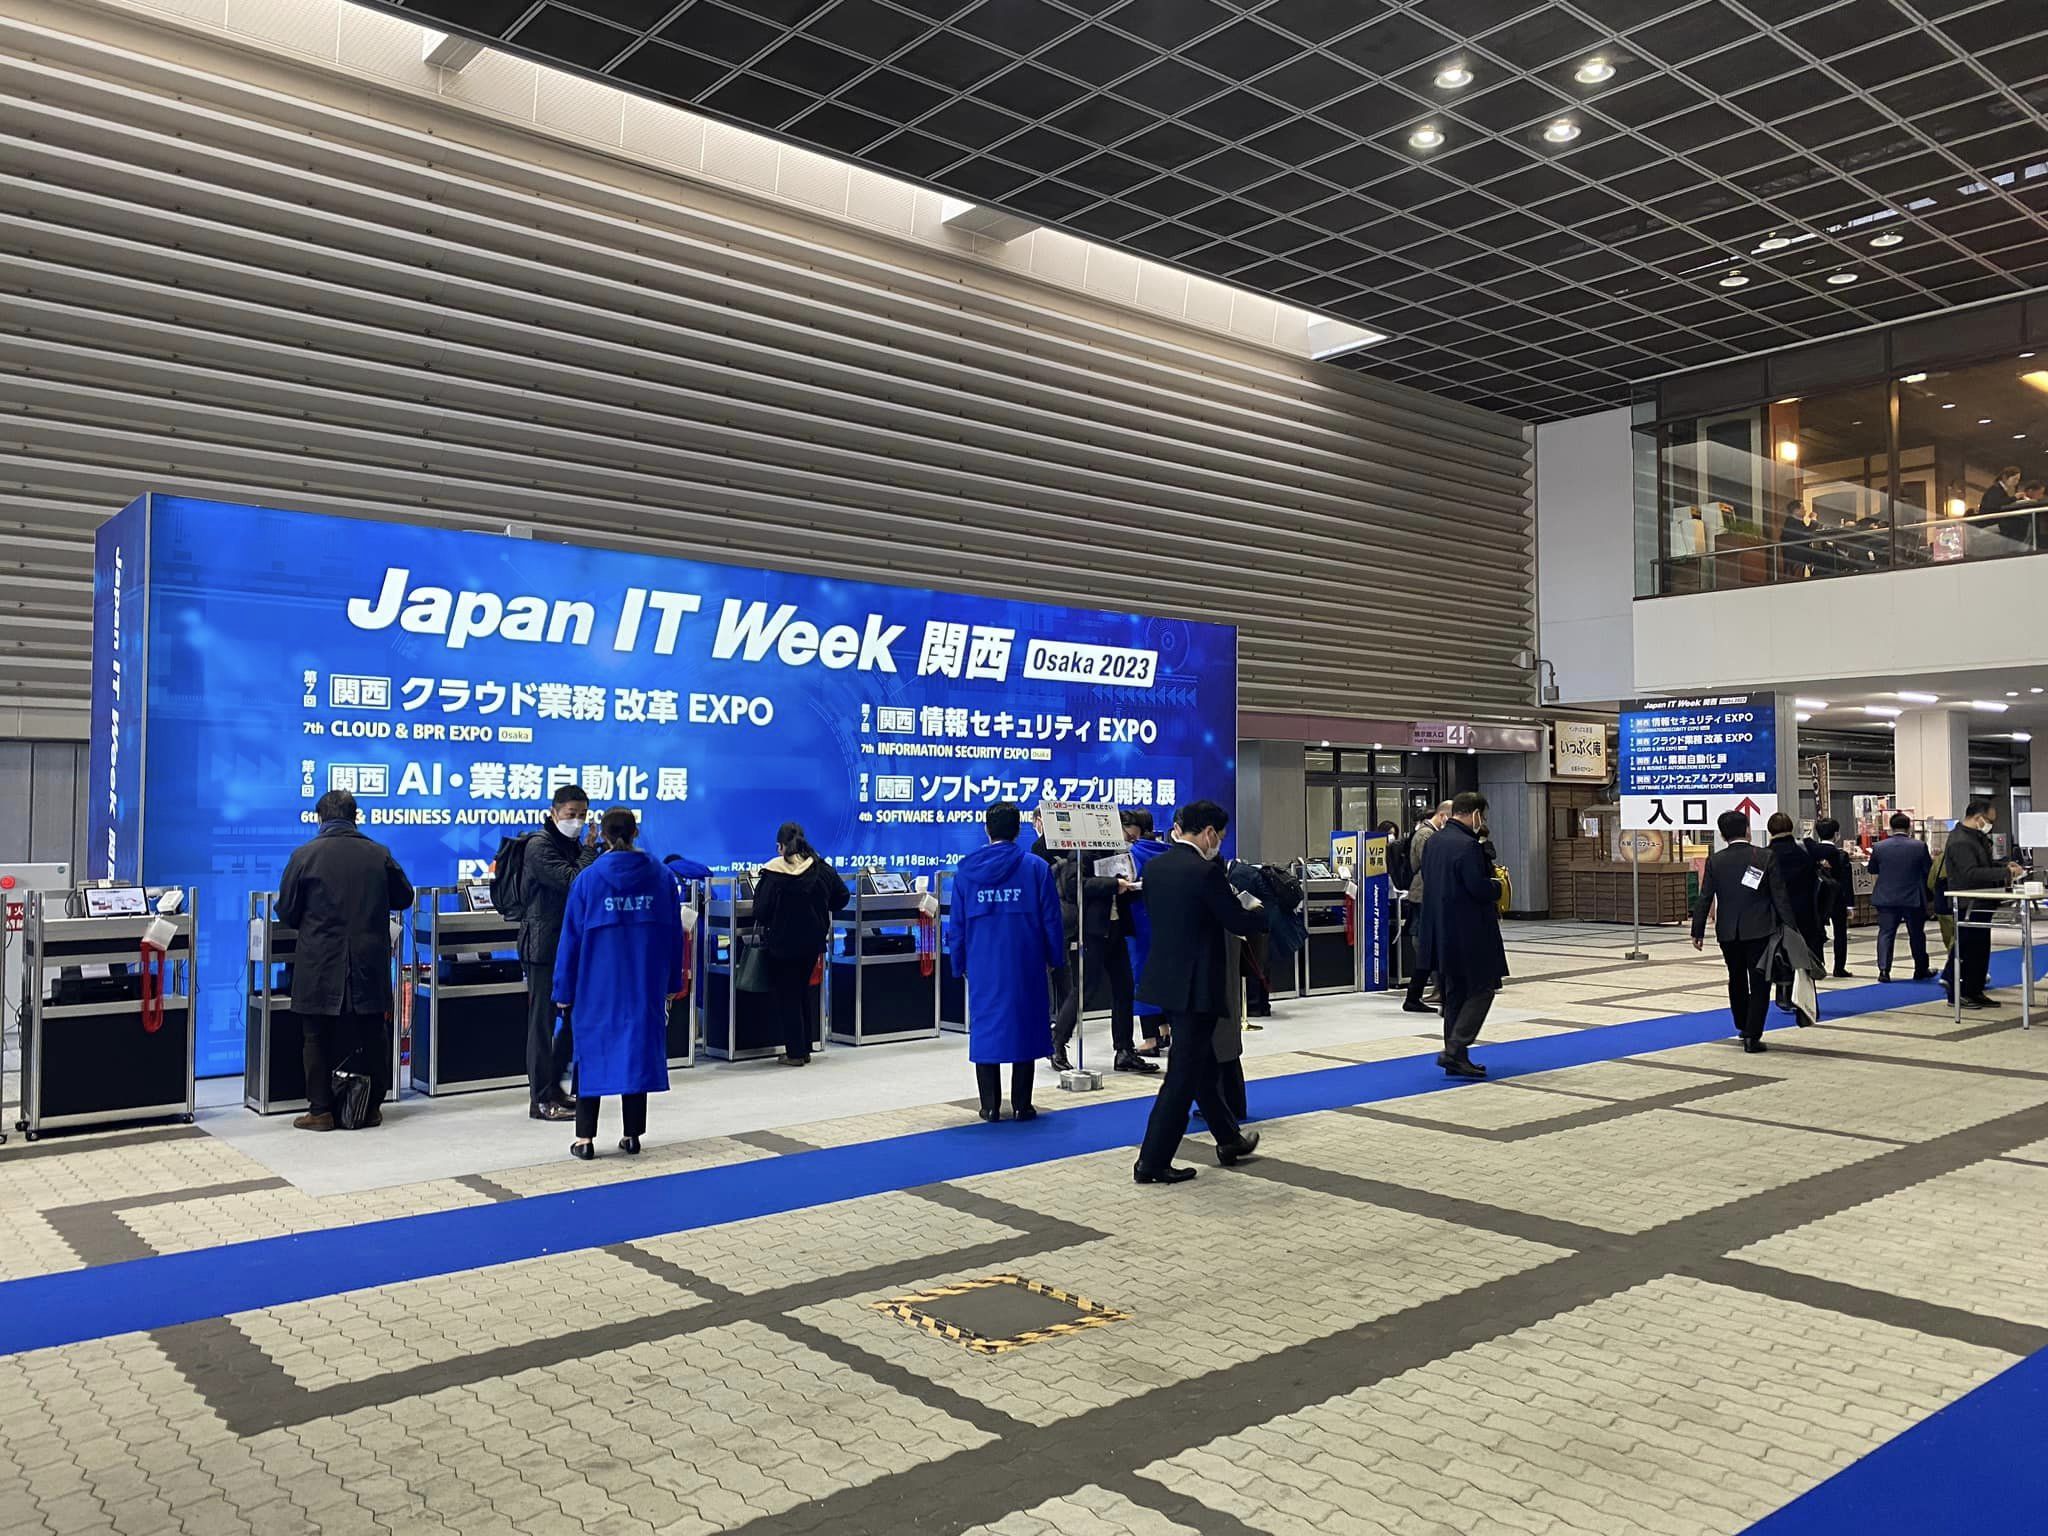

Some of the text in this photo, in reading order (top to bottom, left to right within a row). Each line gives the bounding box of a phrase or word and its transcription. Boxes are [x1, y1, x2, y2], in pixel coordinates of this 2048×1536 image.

[113, 546, 123, 650] Japan
[347, 567, 1016, 682] Japan IT Week 関西
[1032, 647, 1150, 681] Osaka 2023
[111, 660, 121, 701] IT
[333, 677, 774, 726] 関西 クラウド業務 改革 EXPO
[1643, 702, 1667, 710] Japan
[1667, 700, 1677, 708] IT
[879, 706, 1158, 744] 関西 情報セキュリティ EXPO
[1724, 713, 1753, 723] EXPO
[303, 720, 493, 742] 7th CLOUD & BPR EXPO
[501, 729, 529, 740] Osaka
[1725, 733, 1753, 742] EXPO
[861, 742, 1030, 760] 7th INFORMATION SECURITY EXPO
[108, 707, 120, 819] Week
[332, 767, 386, 793] 関西
[655, 767, 689, 801] 展
[878, 778, 912, 799] 関西
[1157, 778, 1176, 806] 展
[371, 809, 451, 825] BUSINESS
[859, 811, 873, 822] 4th
[876, 810, 934, 823] SOFTWARE
[936, 810, 946, 823] &
[947, 810, 974, 823] APPS
[1647, 798, 1708, 825] 入口
[1336, 846, 1353, 856] VIP
[1369, 847, 1384, 856] VIP
[731, 862, 746, 872] RX
[851, 855, 887, 867] 2023年
[604, 895, 654, 911] STAFF
[977, 888, 1022, 903] STAFF
